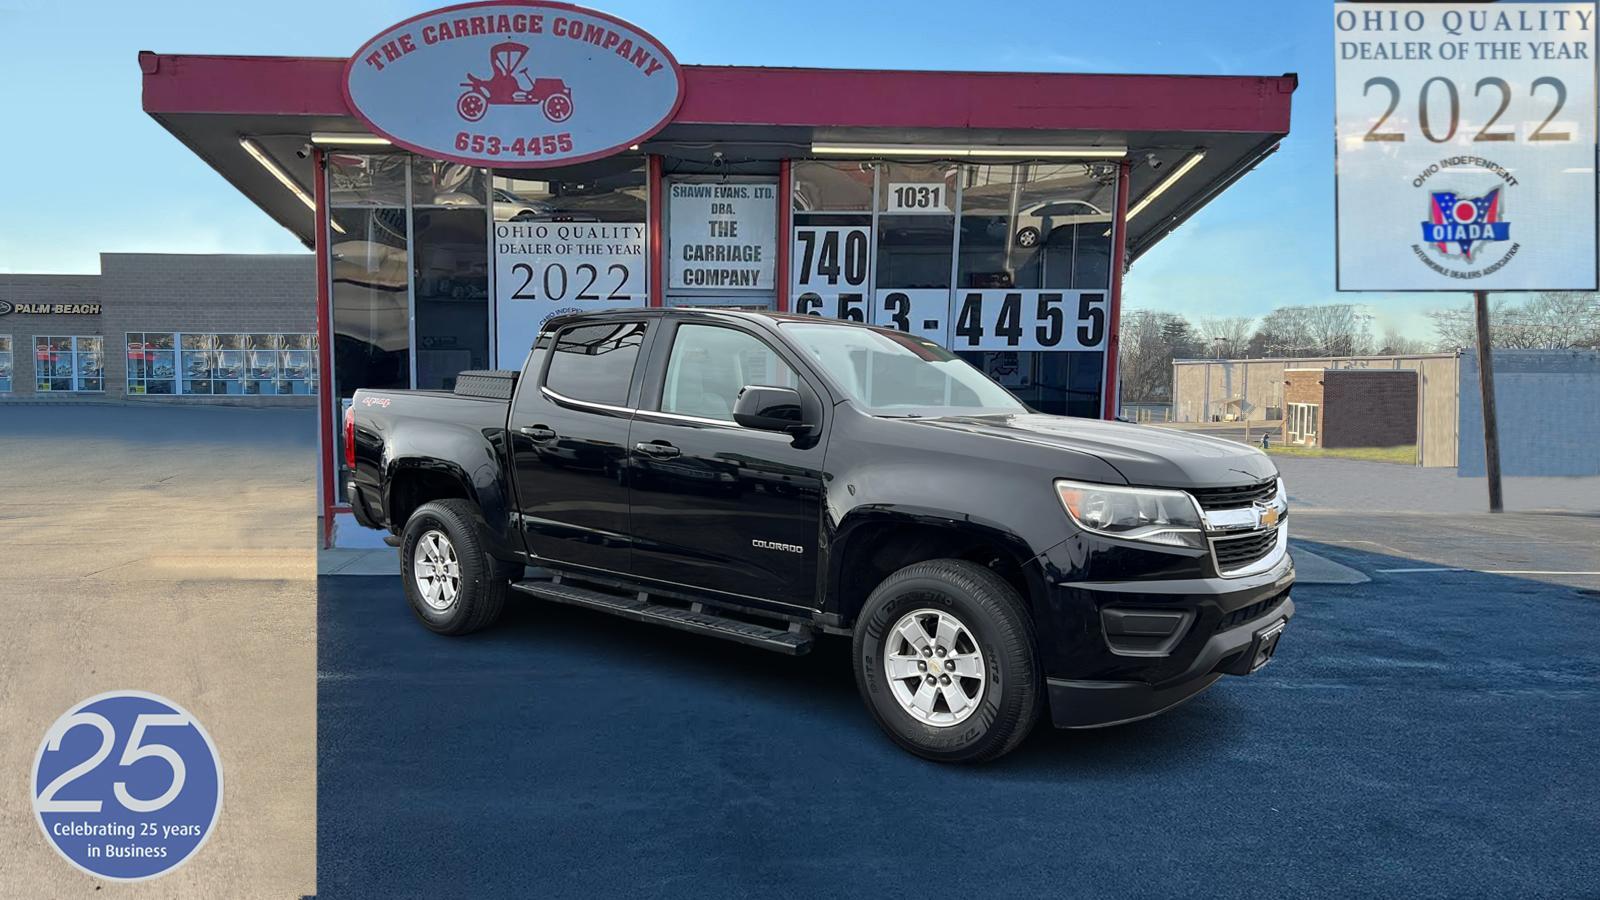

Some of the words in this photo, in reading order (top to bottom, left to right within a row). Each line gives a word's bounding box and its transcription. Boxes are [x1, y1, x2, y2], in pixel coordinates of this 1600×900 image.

[1336, 10, 1425, 31] OHIO
[1442, 10, 1593, 35] QUALITY
[366, 34, 416, 71] THE
[422, 14, 543, 45] CARRIAGE
[553, 17, 664, 77] COMPANY
[1340, 42, 1433, 60] DEALER
[1439, 42, 1469, 60] OF
[1475, 42, 1521, 60] THE
[1528, 42, 1589, 60] YEAR
[1362, 76, 1571, 143] 2022
[454, 132, 573, 156] 653-4455
[1412, 164, 1439, 188] OHIO
[1440, 156, 1519, 187] INDEPENDENT
[673, 186, 712, 198] SHAWN
[754, 187, 775, 199] LTD.
[894, 187, 940, 208] 1031
[711, 203, 736, 215] DBA.
[497, 226, 548, 238] OHIO
[557, 226, 644, 240] QUALITY
[708, 221, 738, 238] THE
[1432, 225, 1496, 240] OIADA
[500, 244, 551, 255] DEALER
[555, 244, 573, 254] OF
[576, 245, 603, 255] THE
[606, 245, 641, 255] YEAR
[683, 244, 762, 262] CARRIAGE
[797, 230, 868, 285] 740
[1450, 270, 1482, 279] DEALERS
[1483, 242, 1521, 275] ASSOCIATION
[511, 263, 631, 300] 2022
[683, 269, 761, 286] COMPANY
[15, 304, 50, 313] PALM
[752, 540, 803, 553] COLORADO
